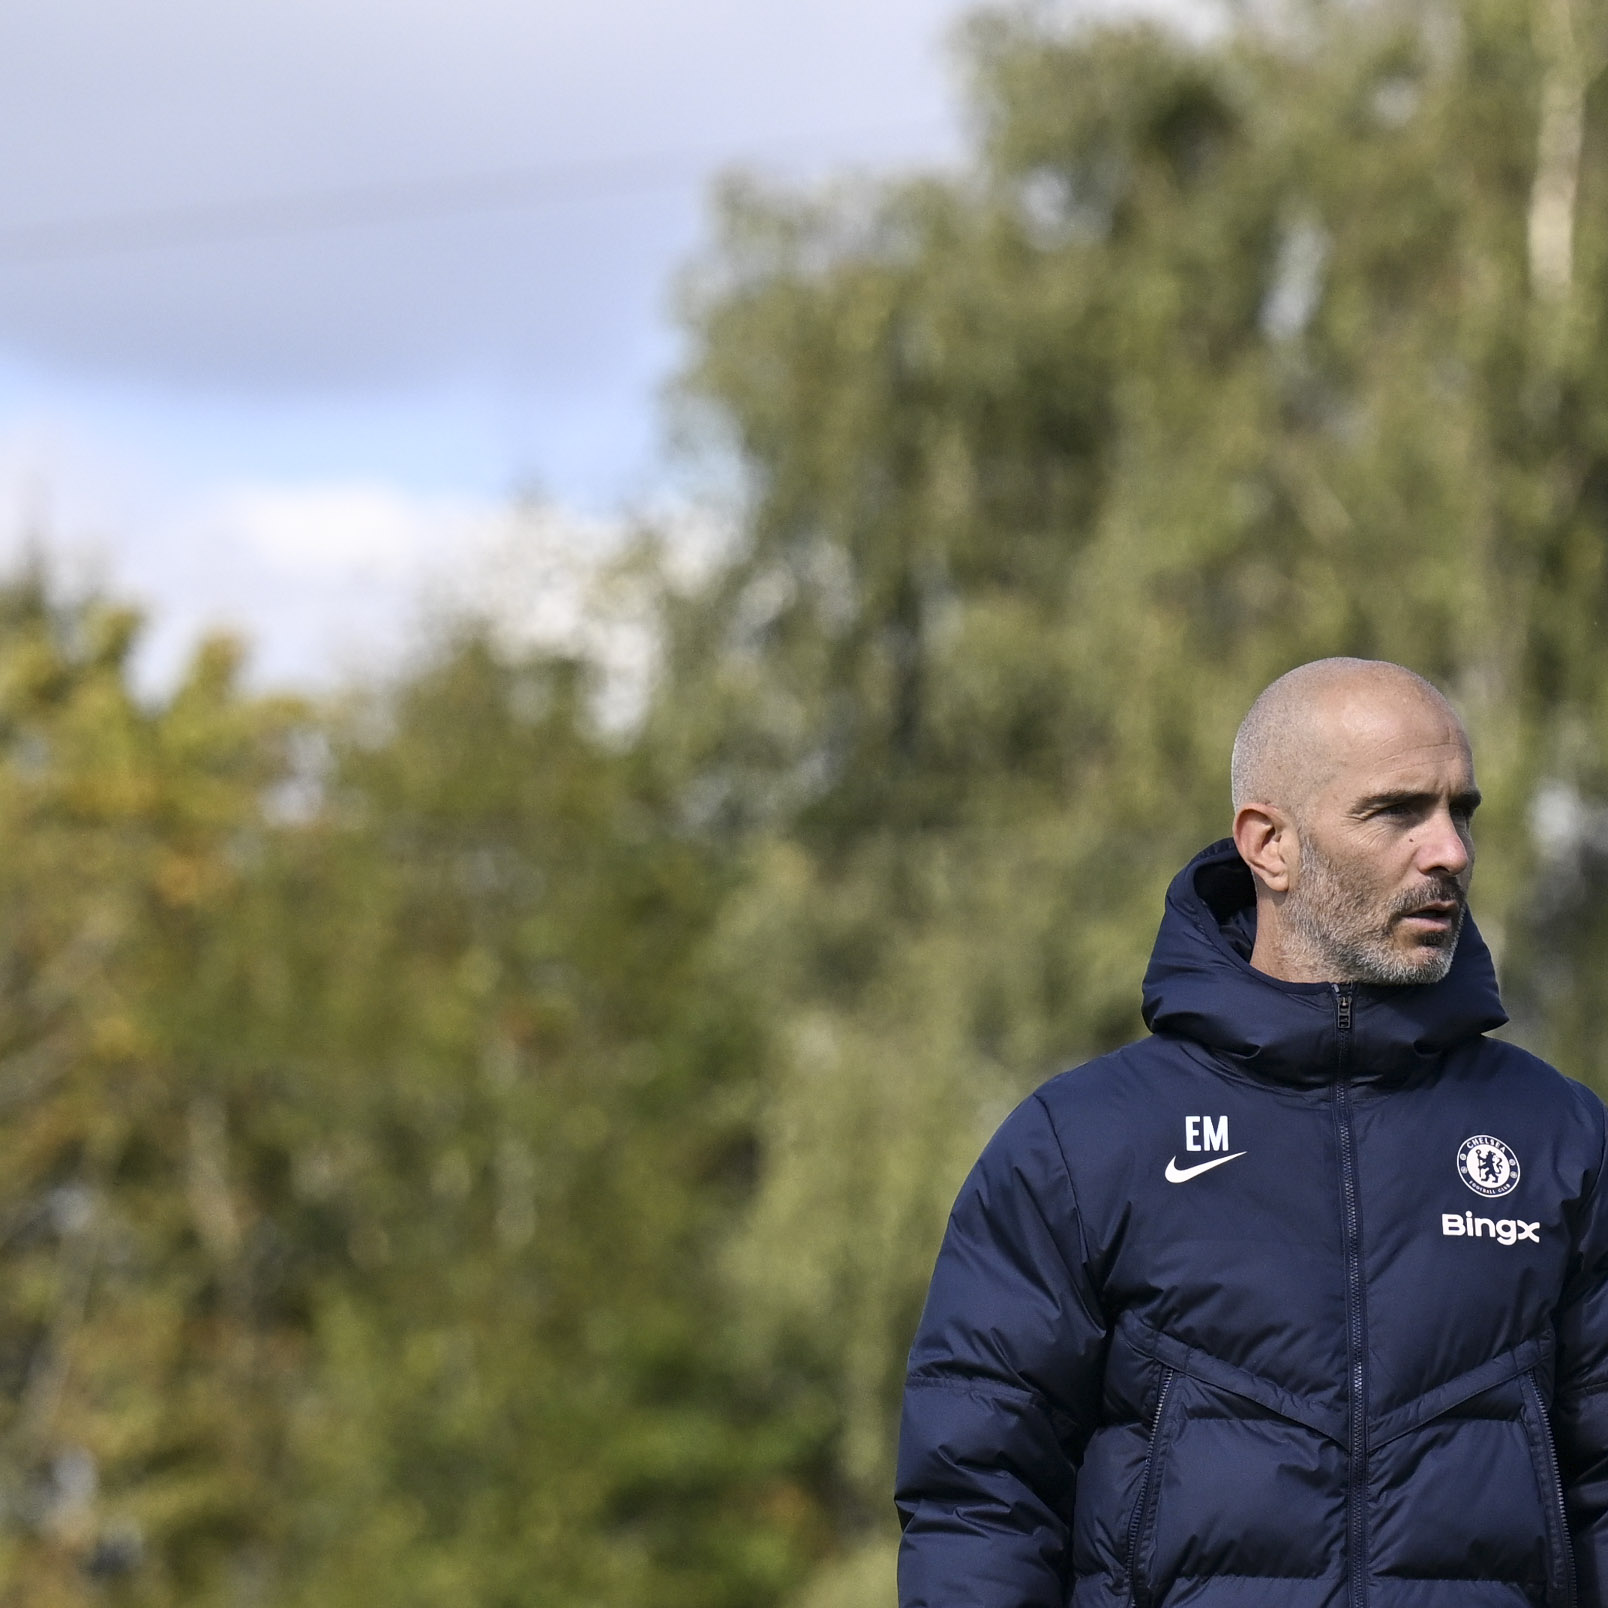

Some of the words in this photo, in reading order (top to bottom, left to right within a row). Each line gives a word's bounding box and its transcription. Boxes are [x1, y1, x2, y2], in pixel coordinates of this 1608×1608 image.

[1185, 1115, 1229, 1152] EM
[1466, 1137, 1506, 1153] CHELSEA
[1469, 1180, 1496, 1194] FOOTBALL
[1497, 1183, 1511, 1193] CLUB
